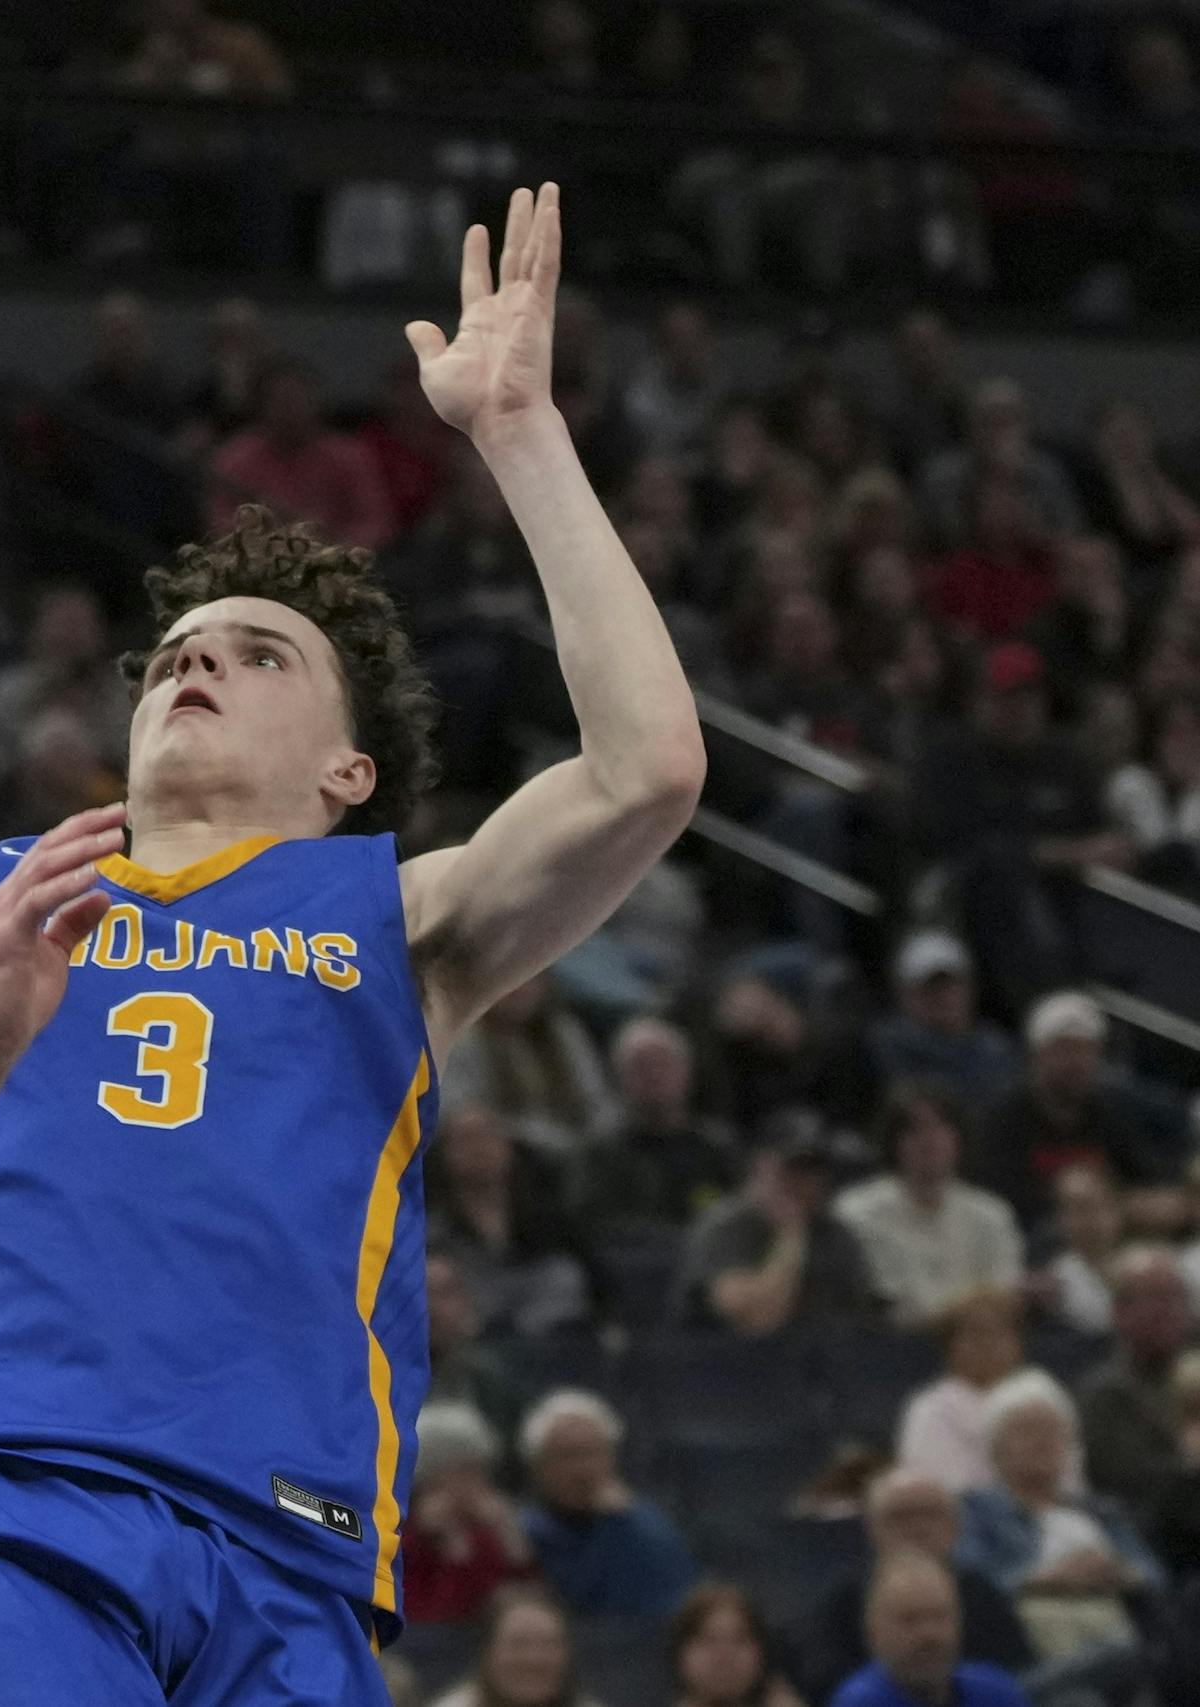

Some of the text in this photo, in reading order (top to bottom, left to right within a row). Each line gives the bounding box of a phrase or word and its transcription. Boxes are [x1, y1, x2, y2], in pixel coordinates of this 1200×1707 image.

[44, 903, 362, 992] OJANS
[97, 991, 214, 1130] 3
[332, 1509, 350, 1526] M
